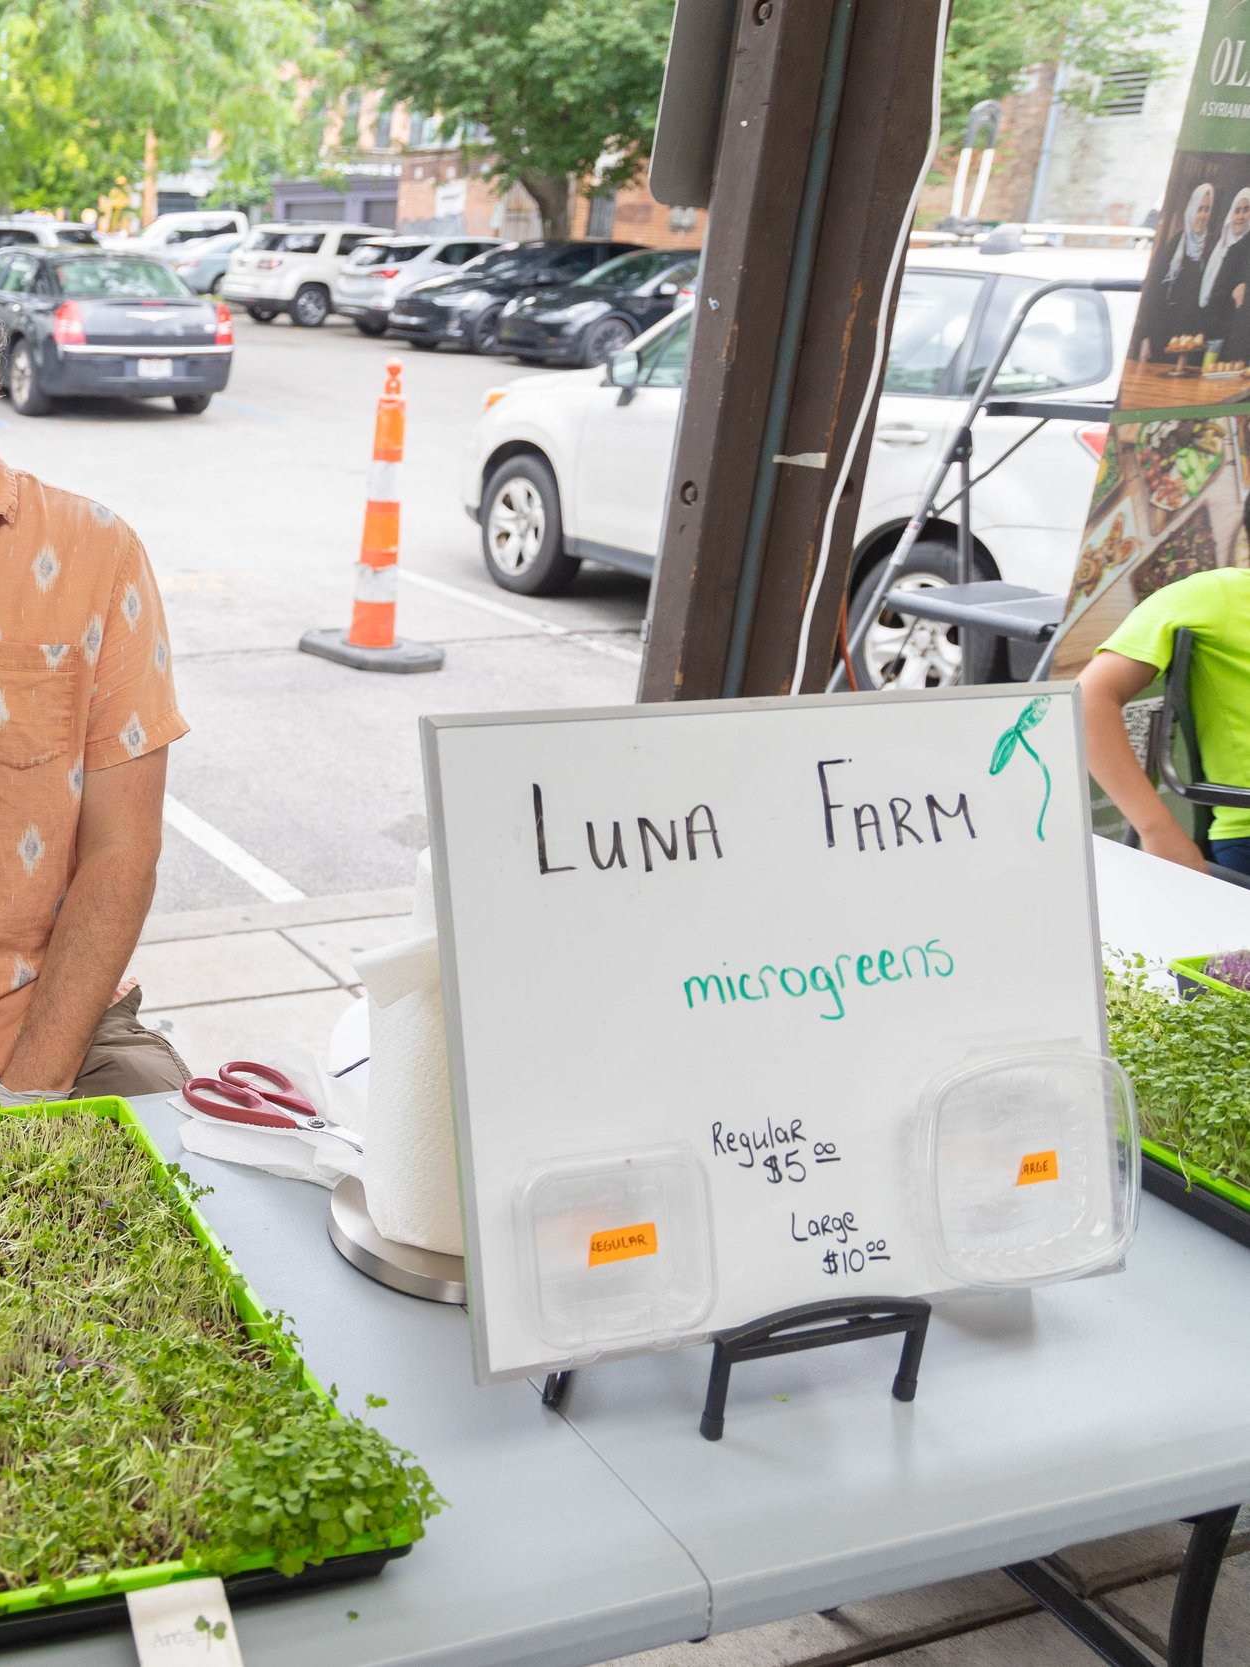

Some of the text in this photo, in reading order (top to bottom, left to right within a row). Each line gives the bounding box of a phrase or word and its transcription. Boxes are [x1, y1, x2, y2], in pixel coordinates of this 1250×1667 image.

[1210, 36, 1250, 87] OL
[1207, 102, 1241, 117] SYRIAN
[532, 758, 977, 875] LUNA FARM
[684, 939, 954, 1020] microgreens
[1021, 1160, 1049, 1176] ARGE
